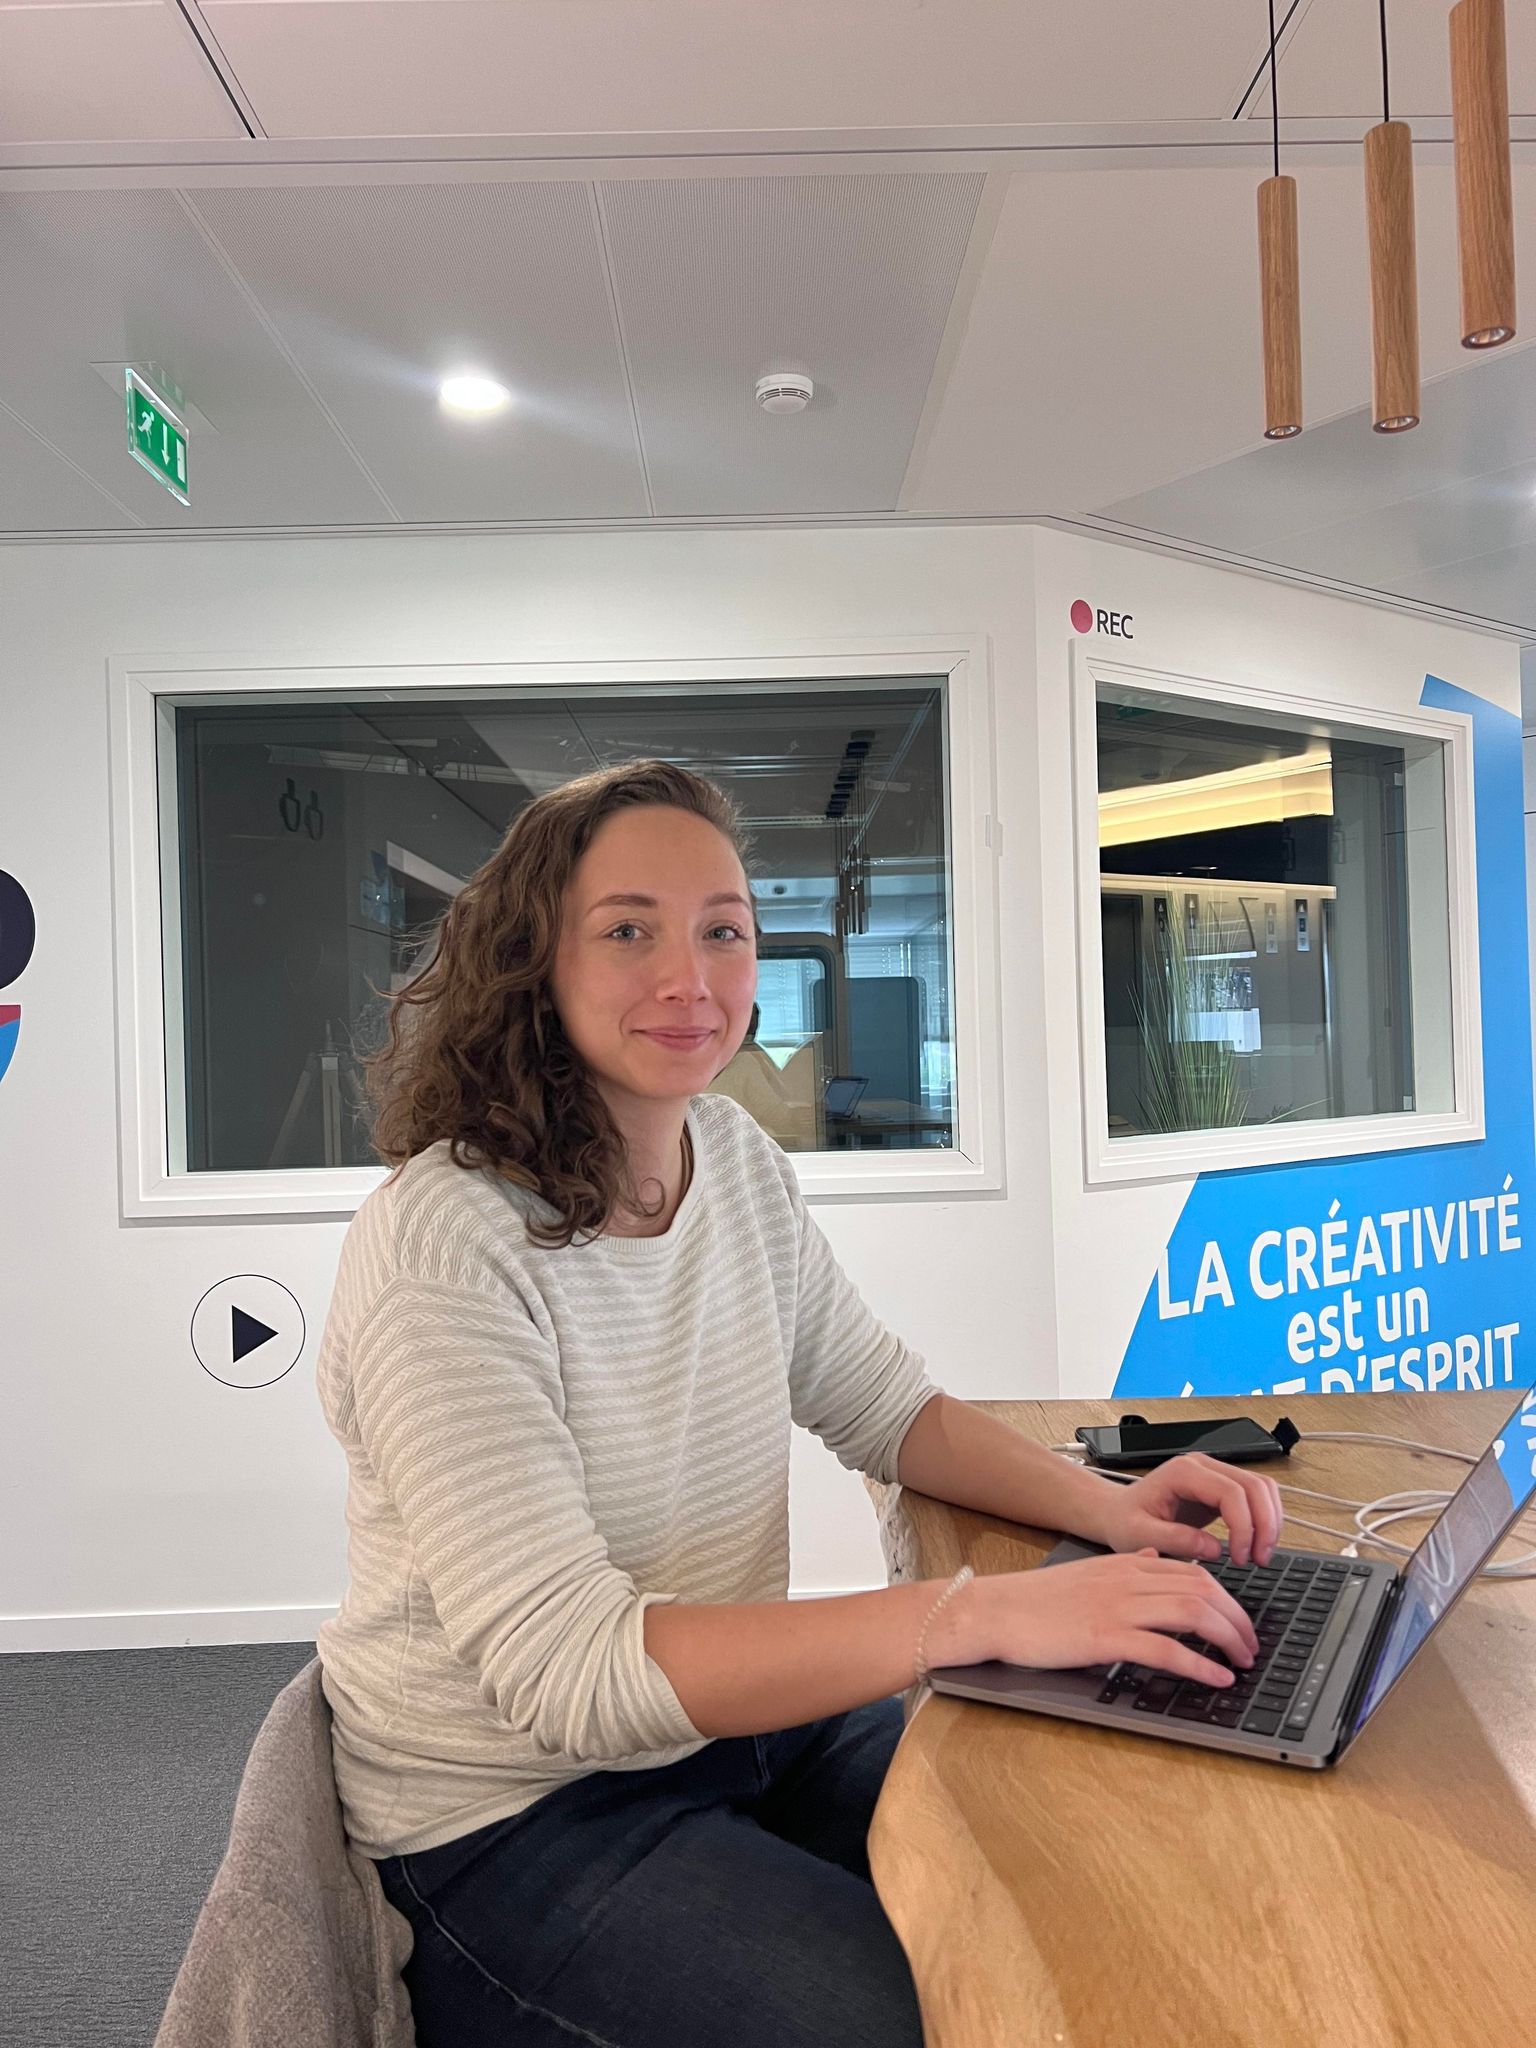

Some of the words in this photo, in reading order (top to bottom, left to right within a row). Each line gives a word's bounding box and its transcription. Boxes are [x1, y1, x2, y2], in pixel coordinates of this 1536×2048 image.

[1096, 608, 1134, 639] REC
[1156, 1240, 1236, 1320] LA
[1249, 1173, 1522, 1300] CRÉATIVITÉ
[1287, 1289, 1365, 1374] est
[1376, 1286, 1430, 1343] un
